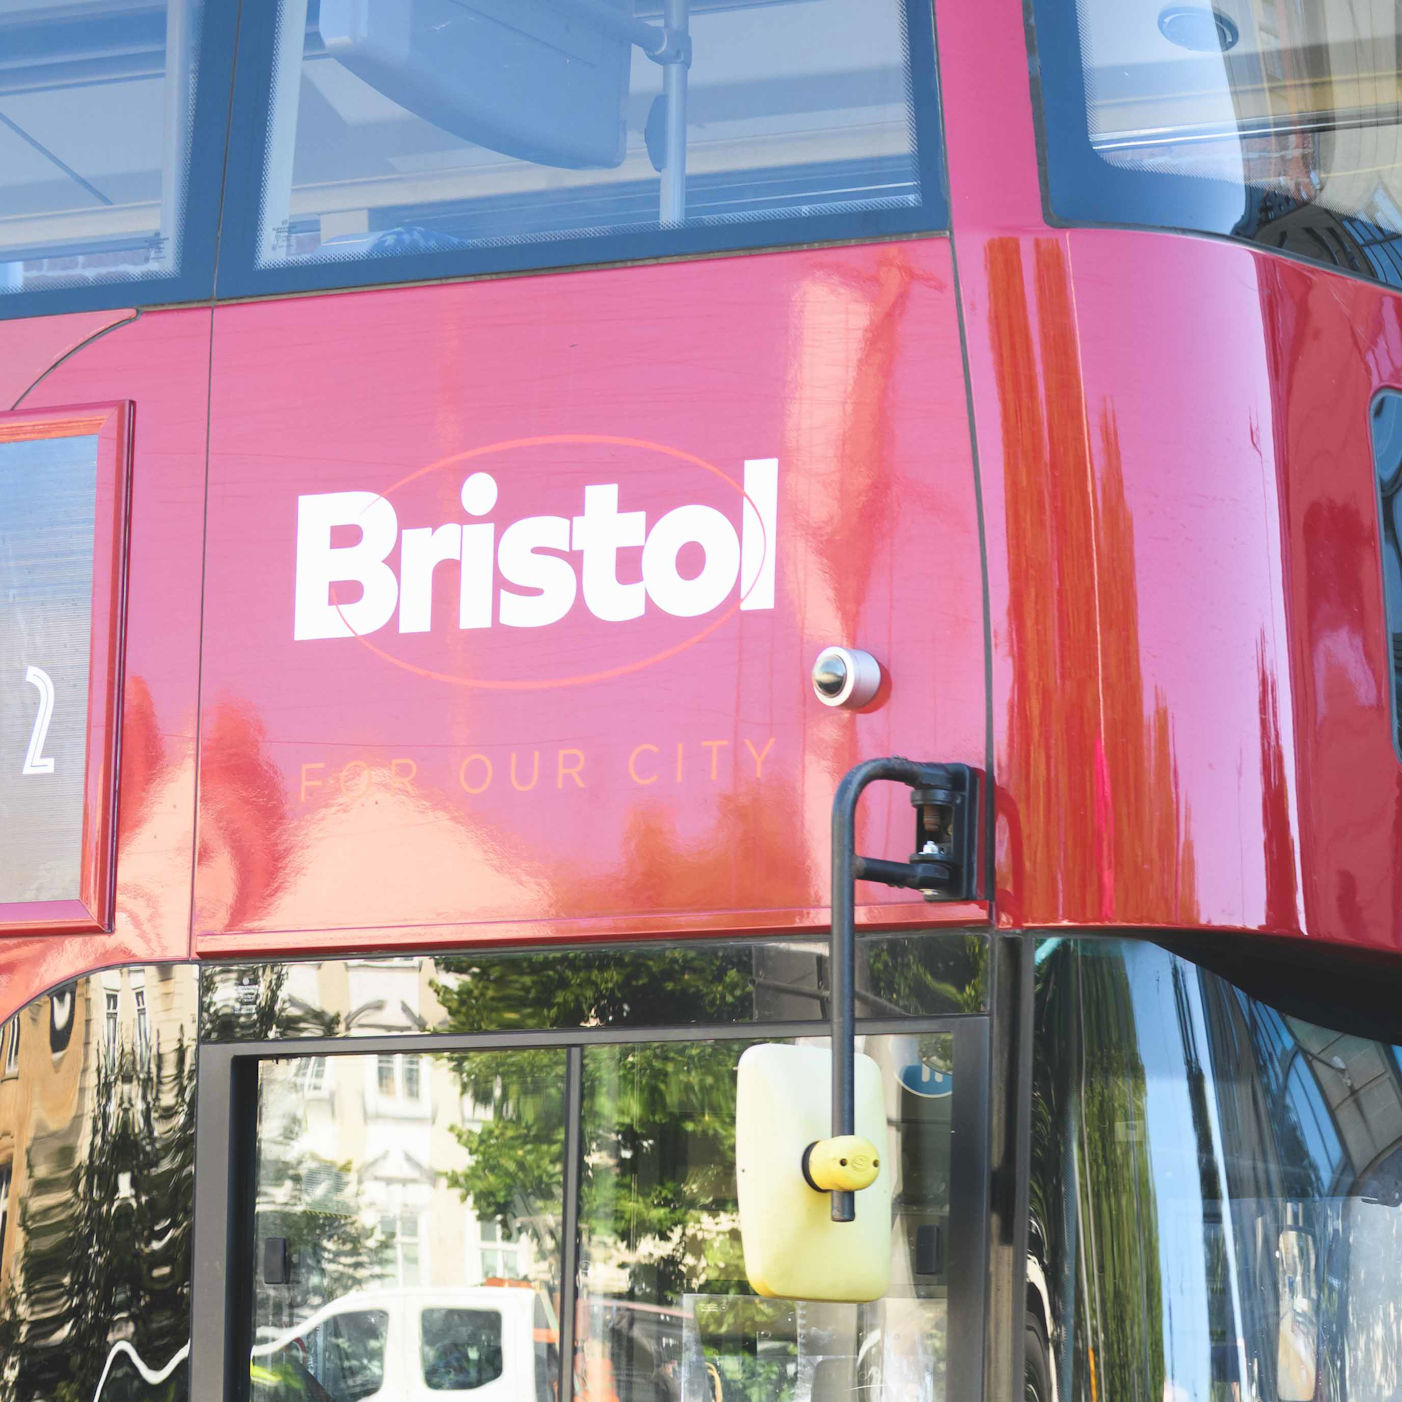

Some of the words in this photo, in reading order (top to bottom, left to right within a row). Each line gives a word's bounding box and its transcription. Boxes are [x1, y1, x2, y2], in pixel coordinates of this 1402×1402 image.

[293, 457, 779, 642] Bristol
[22, 664, 55, 775] 2
[300, 747, 418, 803] FOR
[460, 748, 586, 795] OUR
[628, 736, 777, 786] CITY
